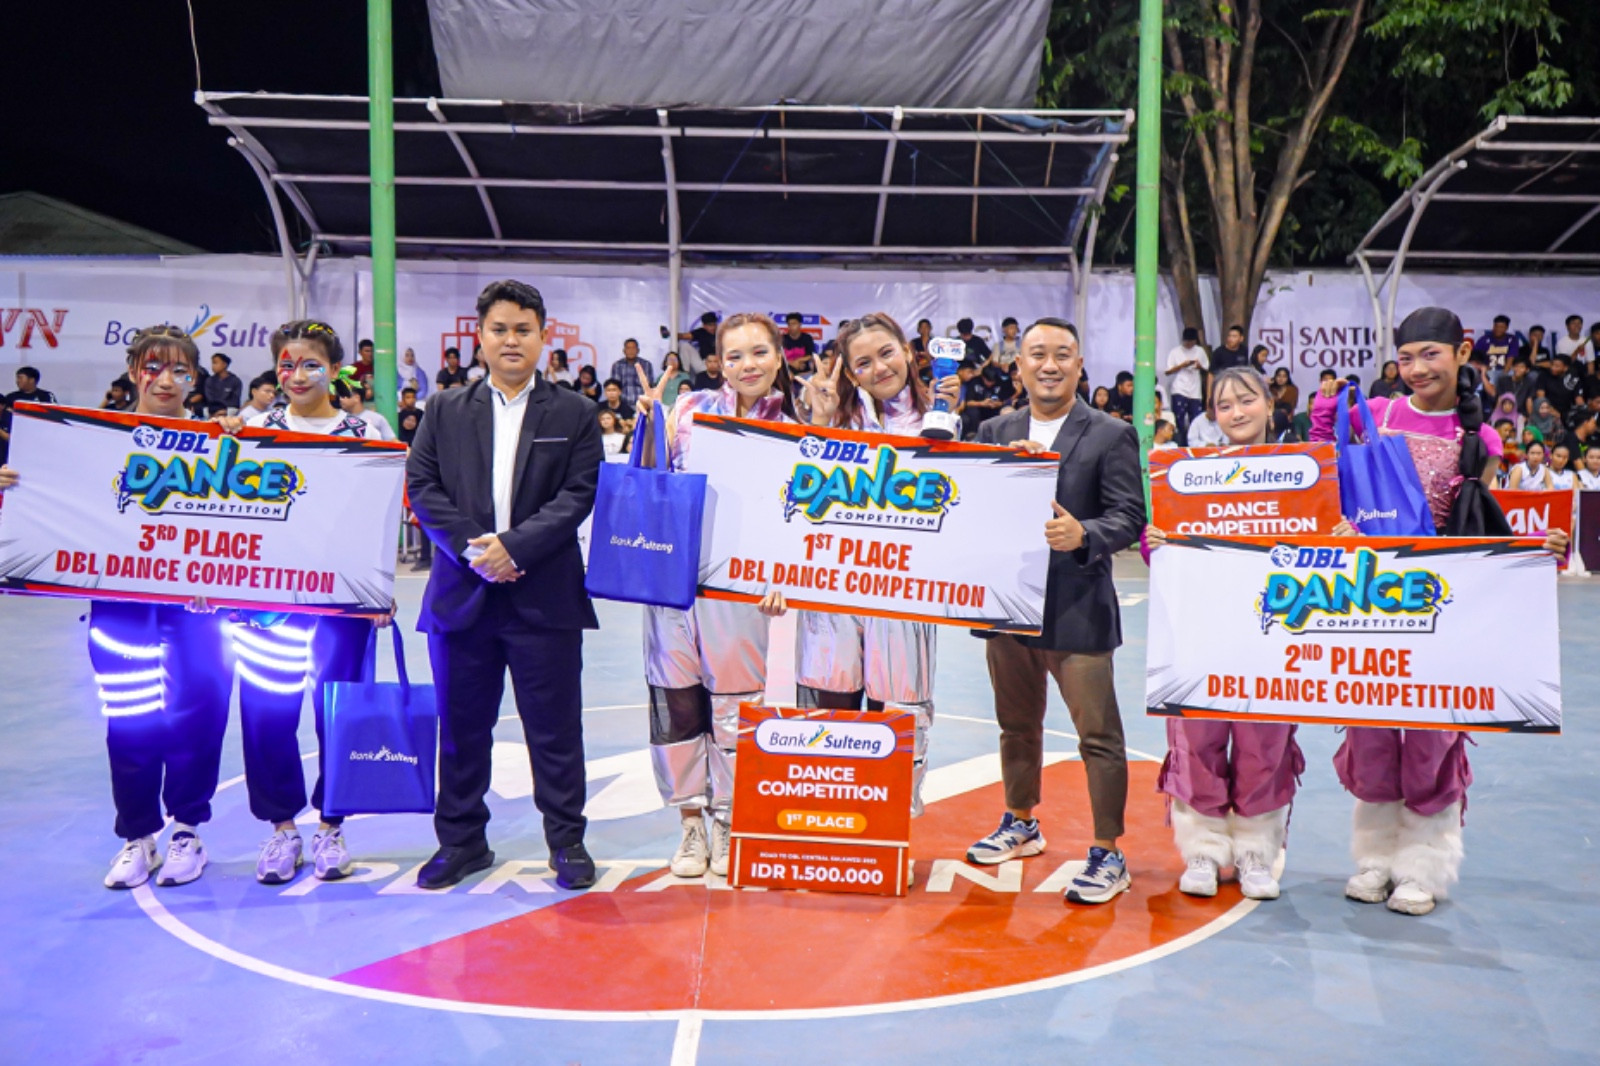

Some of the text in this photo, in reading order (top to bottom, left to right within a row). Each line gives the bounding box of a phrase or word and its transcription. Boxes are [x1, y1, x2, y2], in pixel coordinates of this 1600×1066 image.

[157, 430, 210, 454] DBL
[820, 441, 870, 464] DBL
[126, 437, 291, 509] DANCE
[793, 447, 947, 518] DANCE
[1184, 469, 1304, 487] Bank Sulteng
[174, 501, 282, 515] COMPETITION
[835, 511, 936, 526] COMPETITION
[1207, 501, 1280, 518] DANCE
[1176, 516, 1318, 535] COMPETITION
[139, 524, 262, 560] 3RD PLACE
[803, 533, 912, 571] 1ST PLACE
[1294, 548, 1347, 569] DBL
[55, 550, 335, 594] DBL DANCE COMPETITION
[729, 557, 985, 608] DBL DANCE COMPETITION
[1266, 550, 1436, 628] DANCE
[1316, 619, 1428, 628] COMPETITION
[1284, 643, 1412, 677] 2ND PLACE
[1207, 674, 1495, 711] DBL DANCE COMPETITION
[769, 732, 882, 754] Bank Sulteng
[350, 750, 374, 761] Bank
[788, 764, 855, 782] DANCE
[757, 781, 888, 801] COMPETITION
[786, 813, 855, 829] 1ST PLACE
[751, 863, 884, 886] IDR 1.500.000
